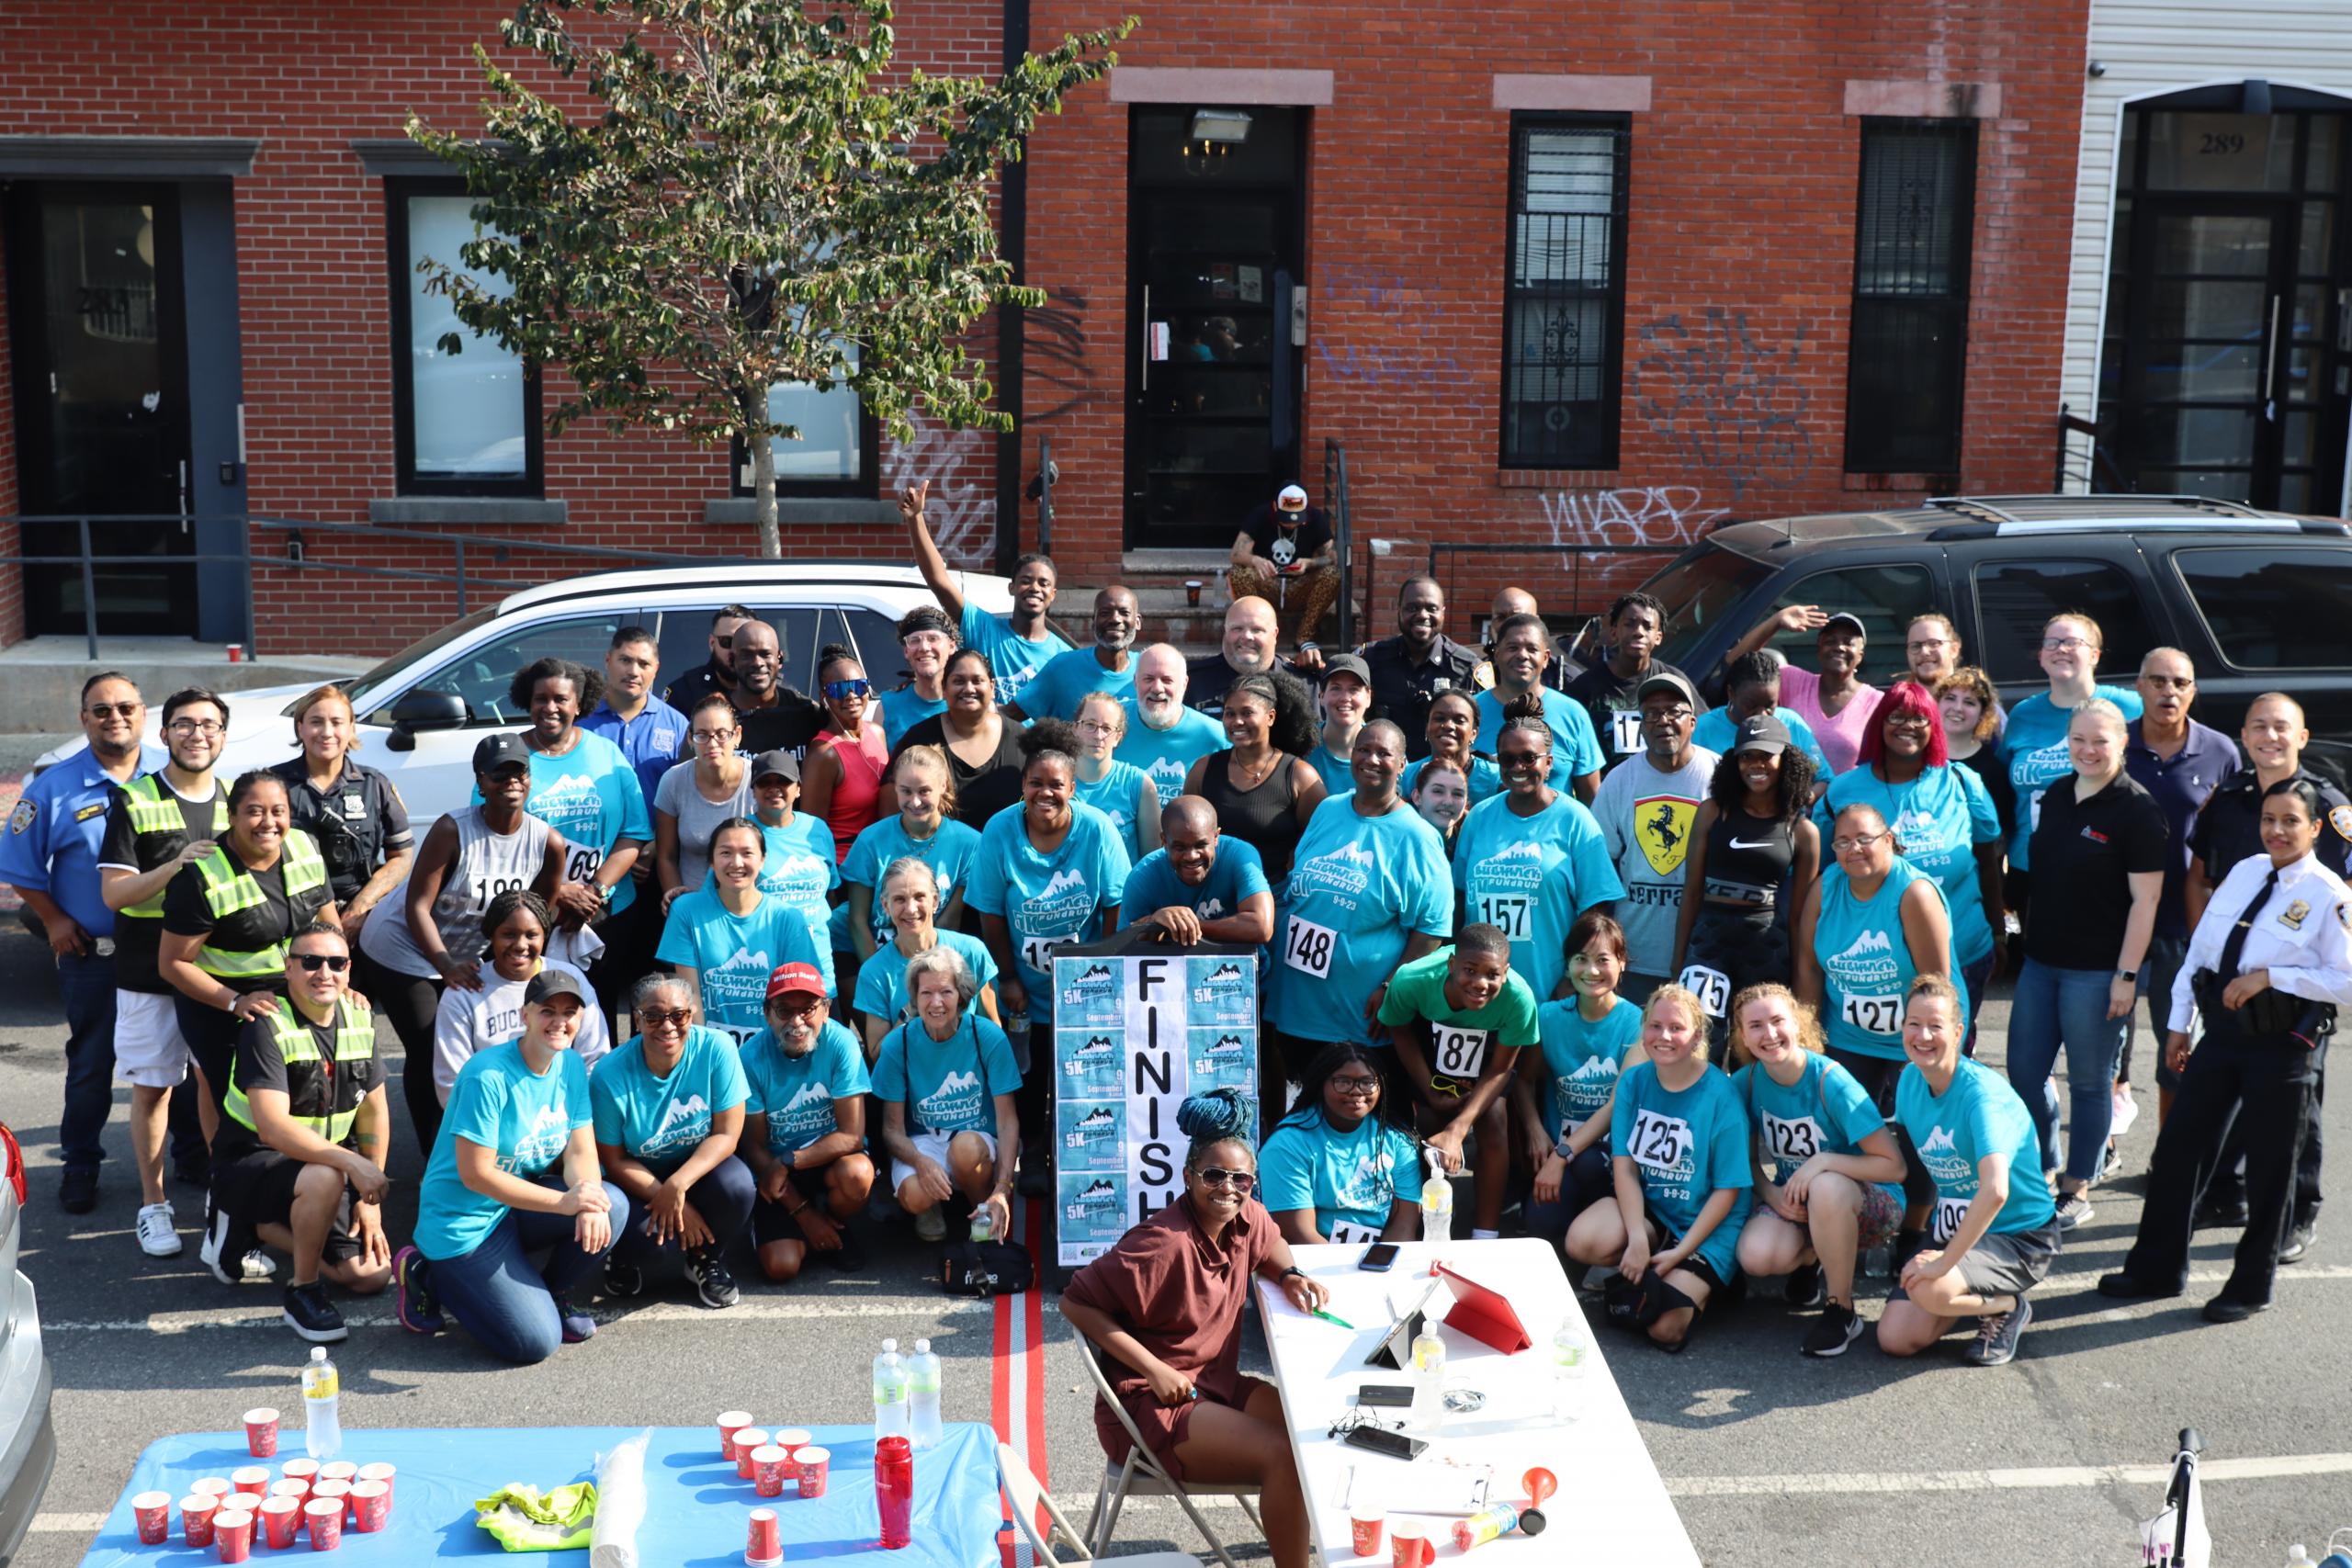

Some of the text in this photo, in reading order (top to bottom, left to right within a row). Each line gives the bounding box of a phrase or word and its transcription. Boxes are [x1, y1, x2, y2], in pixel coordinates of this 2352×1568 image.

[2199, 132, 2245, 154] 289
[1332, 895, 1358, 911] 9-9-23
[1481, 897, 1528, 937] 157
[1287, 922, 1331, 972] 148
[1064, 988, 1082, 1005] 5K
[1194, 987, 1213, 1003] 5K
[1847, 999, 1898, 1032] 127
[1432, 1030, 1483, 1072] 187
[1065, 1060, 1084, 1076] 5K
[1195, 1058, 1215, 1074] 5K
[1135, 960, 1175, 1225] FINISH
[1067, 1133, 1085, 1147] 5K
[1633, 1115, 1680, 1164] 125
[1767, 1118, 1816, 1157] 123
[1067, 1204, 1087, 1220] 5K
